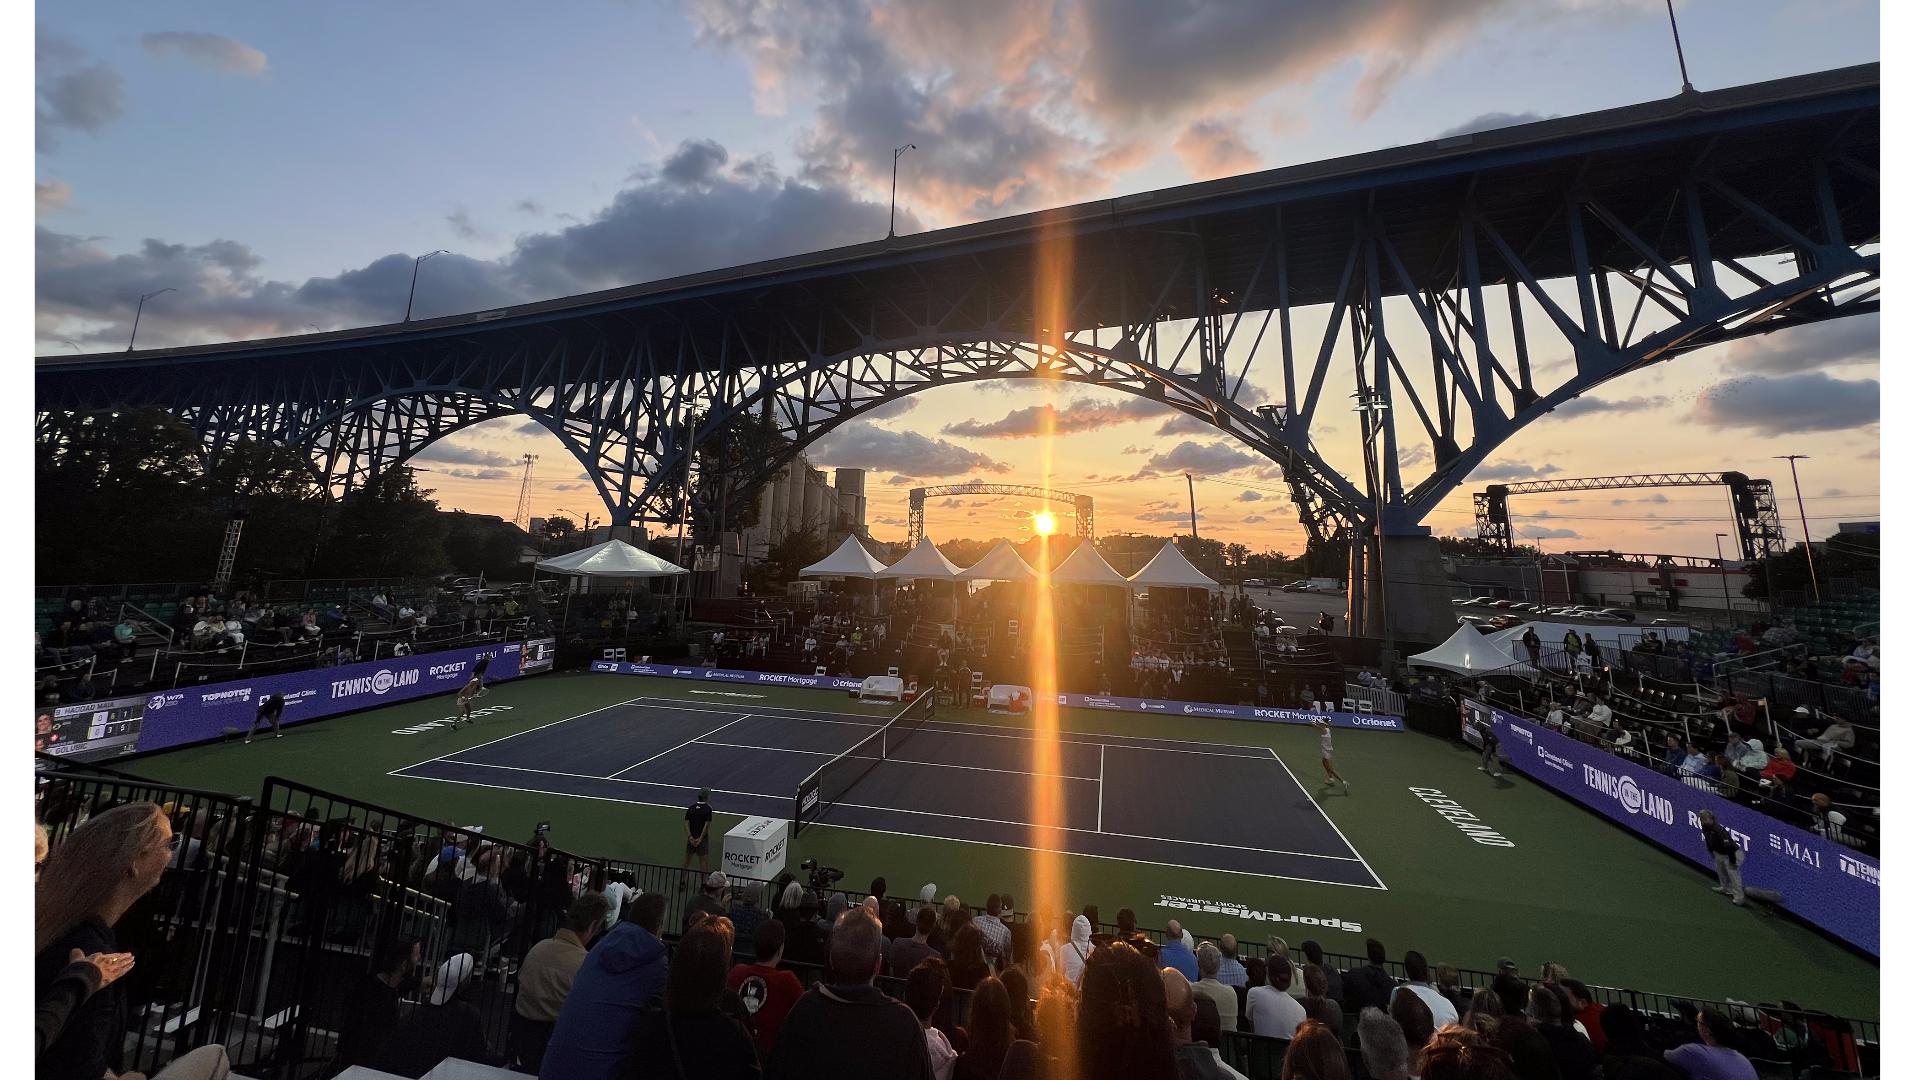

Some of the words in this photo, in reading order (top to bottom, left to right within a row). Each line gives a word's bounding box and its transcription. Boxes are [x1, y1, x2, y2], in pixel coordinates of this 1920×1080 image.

[429, 661, 467, 676] ROCKET
[331, 676, 372, 699] TENNIS
[393, 668, 420, 688] LAND
[759, 673, 788, 683] ROCKET
[788, 676, 818, 686] Mortgage
[201, 688, 252, 702] TOPNOTCH
[65, 704, 96, 715] HADDAD
[97, 702, 114, 710] MAIA
[1254, 708, 1291, 719] ROCKET
[391, 705, 514, 735] CLELAND
[107, 726, 113, 734] 3
[55, 743, 88, 754] GOLUBIC
[1582, 763, 1619, 799] TENNIS
[1641, 789, 1674, 825] LAND
[1408, 786, 1516, 848] CLEVELAND
[764, 838, 786, 862] ROCKET
[1784, 838, 1821, 868] MAI
[724, 852, 761, 865] ROCKET
[1160, 894, 1212, 907] SURFACES
[1214, 900, 1248, 910] SPORT
[1153, 899, 1363, 933] SportMaster
